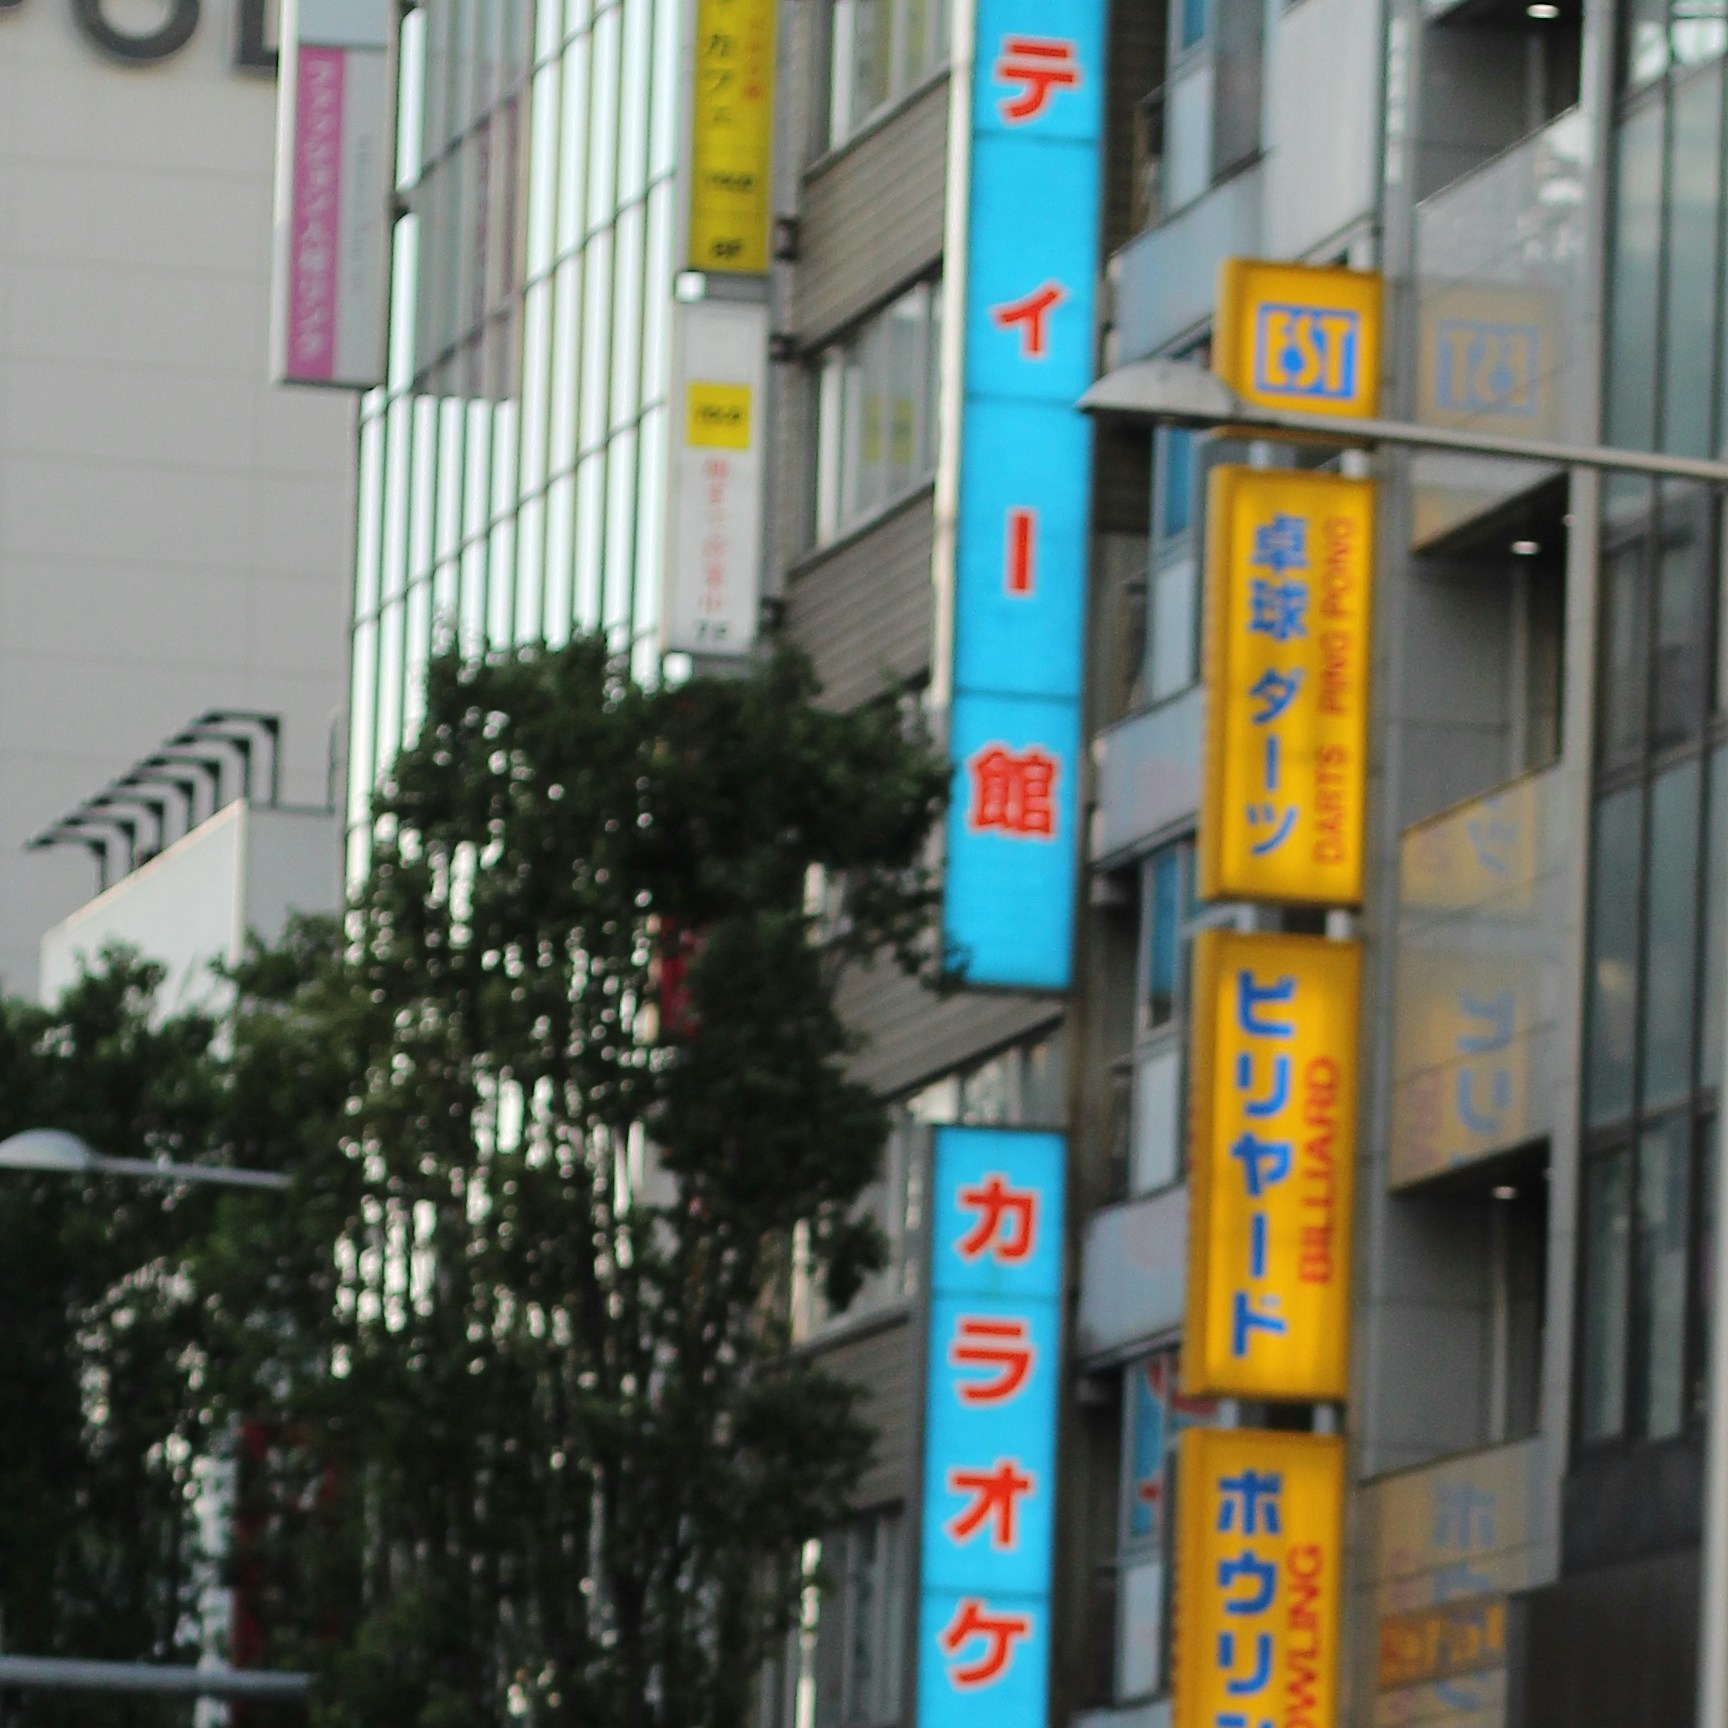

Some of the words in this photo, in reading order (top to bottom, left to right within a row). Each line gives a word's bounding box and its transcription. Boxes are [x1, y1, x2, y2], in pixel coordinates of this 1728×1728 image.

[1265, 310, 1351, 391] EST
[1246, 512, 1309, 641] 卓球
[1317, 515, 1356, 619] PONG
[1317, 629, 1352, 718] PING
[1245, 665, 1307, 857] ダーツ
[1312, 744, 1348, 867] DARTS
[1229, 969, 1297, 1358] ビリヤード
[1299, 1055, 1339, 1285] BILLIARD
